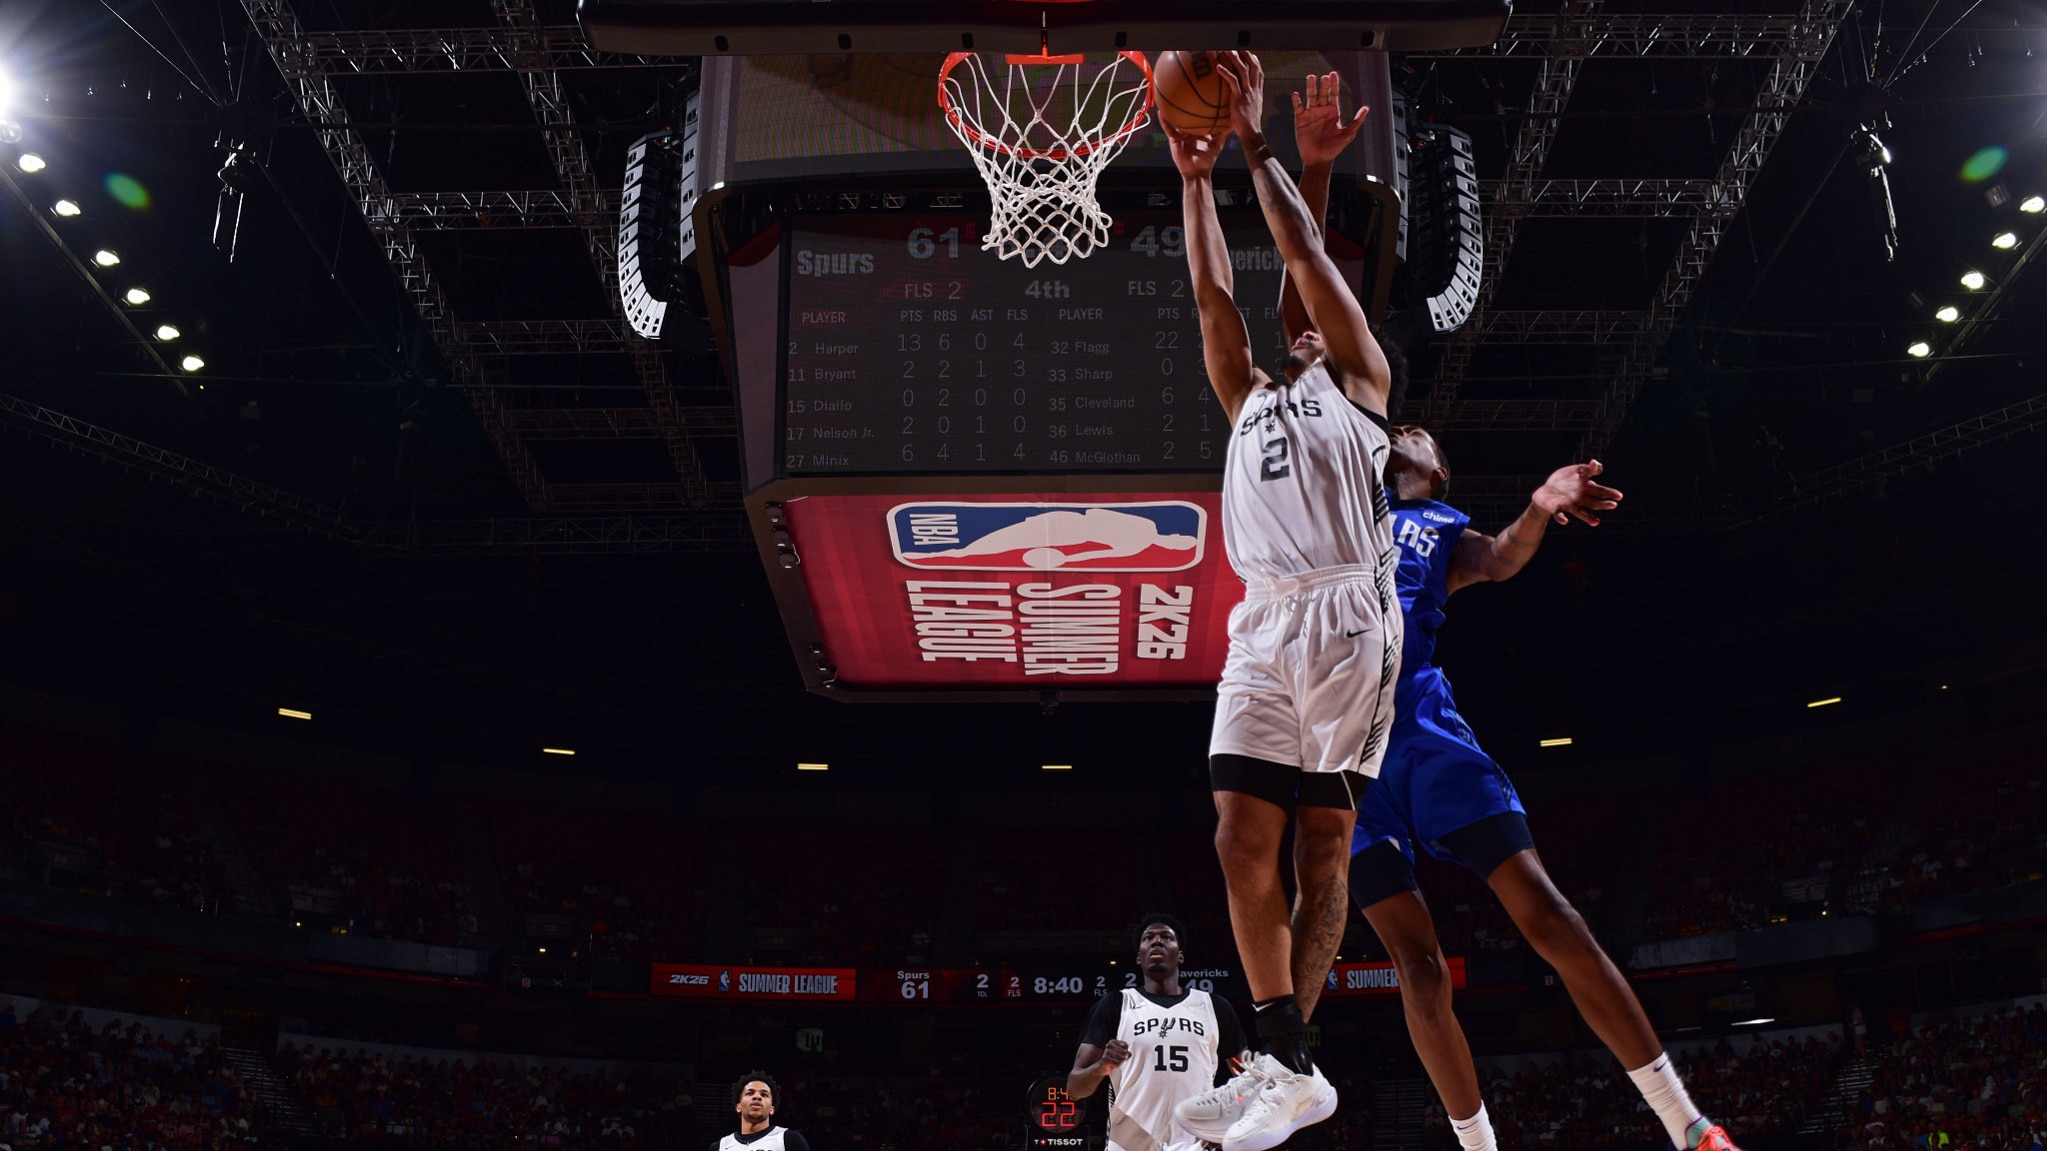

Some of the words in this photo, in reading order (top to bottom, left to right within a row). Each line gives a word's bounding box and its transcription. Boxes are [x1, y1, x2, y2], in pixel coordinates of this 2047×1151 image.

[907, 227, 960, 259] 61
[1130, 225, 1185, 257] 49
[797, 249, 874, 277] Spurs
[1231, 246, 1283, 271] erick
[904, 283, 933, 298] FLS
[948, 281, 961, 299] 2
[1025, 280, 1070, 298] 4th
[1128, 280, 1157, 296] FLS
[1171, 280, 1184, 298] 2
[802, 311, 846, 324] PLAYER
[900, 310, 923, 322] PTS
[934, 309, 958, 321] RBS
[971, 309, 993, 321] AST
[1007, 309, 1028, 321] FLS
[1059, 308, 1103, 320] PLAYER
[1158, 307, 1180, 319] PTS
[788, 343, 798, 355] 2
[815, 343, 859, 357] Harper
[898, 334, 921, 352] 13
[939, 334, 950, 351] 6
[975, 333, 986, 350] 0
[1013, 333, 1025, 350] 4
[1051, 341, 1069, 354] 32
[1075, 341, 1110, 355] Flagg
[1155, 332, 1179, 349] 22
[788, 369, 805, 382] 11
[815, 369, 856, 382] Bryant
[903, 361, 914, 379] 2
[939, 360, 950, 378] 2
[976, 360, 986, 378] 1
[1014, 359, 1025, 377] 3
[1049, 369, 1067, 382] 33
[1075, 368, 1113, 382] Sharp
[1162, 358, 1173, 376] 0
[788, 401, 805, 414] 15
[814, 400, 852, 412] Diallo
[903, 389, 914, 407] 0
[939, 389, 950, 407] 2
[975, 388, 986, 406] 0
[1014, 388, 1025, 406] 0
[1049, 398, 1067, 411] 35
[1075, 396, 1135, 409] Cleveland
[1162, 387, 1174, 404] 6
[1198, 387, 1210, 404] 4
[787, 428, 805, 441] 17
[814, 427, 857, 439] Nelson
[861, 427, 875, 439] Jr.
[902, 416, 913, 435] 2
[938, 416, 950, 434] 0
[976, 416, 986, 433] 1
[1014, 416, 1026, 433] 0
[1049, 425, 1067, 438] 36
[1075, 424, 1113, 436] Lewis
[1163, 414, 1174, 432] 2
[1201, 414, 1211, 432] 1
[787, 455, 804, 468] 27
[813, 454, 849, 467] Minix
[902, 444, 913, 462] 6
[937, 444, 949, 461] 4
[976, 443, 986, 461] 1
[1013, 443, 1025, 461] 4
[1049, 450, 1068, 464] 46
[1075, 452, 1140, 465] McGlothan
[1163, 442, 1174, 459] 2
[1200, 441, 1211, 459] 5
[1261, 437, 1290, 482] 2
[1422, 511, 1455, 524] chime
[909, 513, 960, 546] NBA
[906, 580, 1018, 662] LEAGUE
[1016, 582, 1122, 676] SUMMER
[1137, 583, 1193, 660] 2K26
[669, 974, 709, 985] 2K26
[738, 973, 790, 993] SUMMER
[794, 975, 838, 994] LEAGUE
[897, 970, 930, 981] Spurs
[976, 973, 989, 988] 2
[1010, 976, 1020, 988] 2
[1095, 976, 1106, 987] 2
[1125, 973, 1137, 987] 2
[1179, 969, 1229, 978] avericks
[1346, 968, 1400, 989] SUMMER
[901, 981, 929, 999] 61
[1008, 989, 1021, 997] FLS
[1034, 977, 1083, 994] 8:40
[1184, 979, 1214, 994] 49
[1154, 1045, 1188, 1072] 15
[1048, 1087, 1069, 1101] 8:4
[1041, 1102, 1076, 1127] 22
[1047, 1138, 1084, 1146] TISSOT
